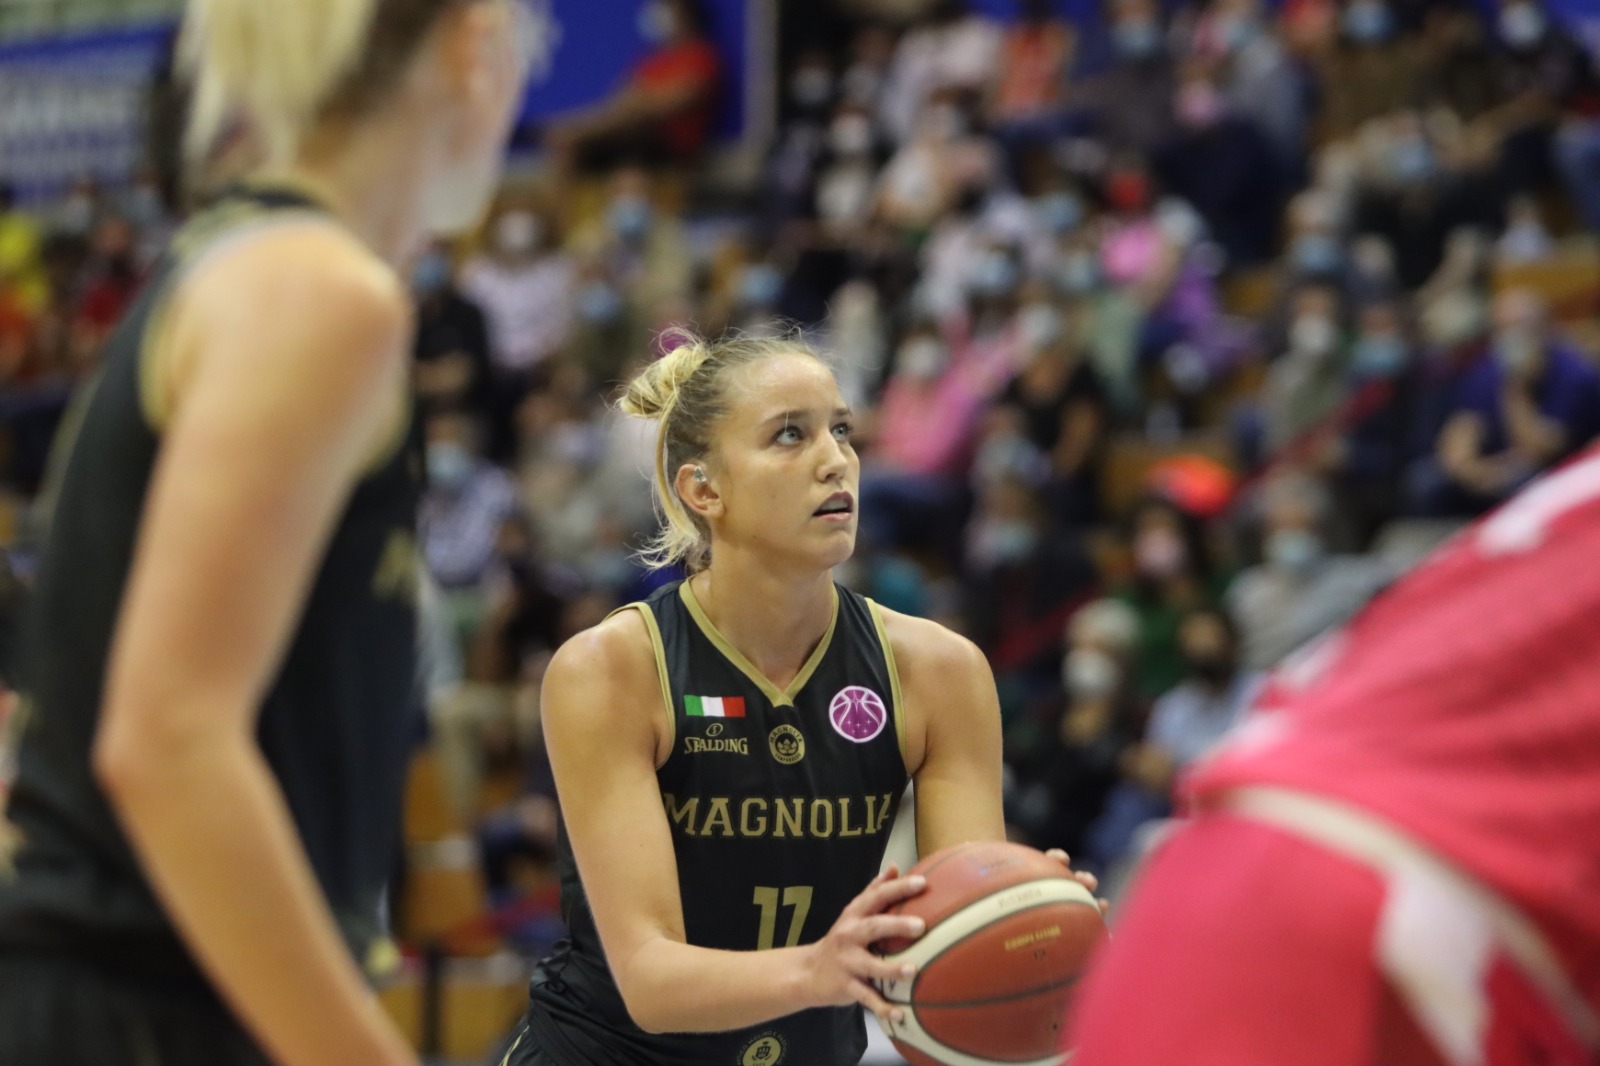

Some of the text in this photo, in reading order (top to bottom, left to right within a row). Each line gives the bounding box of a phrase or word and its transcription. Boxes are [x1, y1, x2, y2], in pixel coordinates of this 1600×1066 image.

[769, 726, 803, 743] MAGNOLIA
[684, 736, 748, 755] SPALDING
[752, 885, 813, 951] 17
